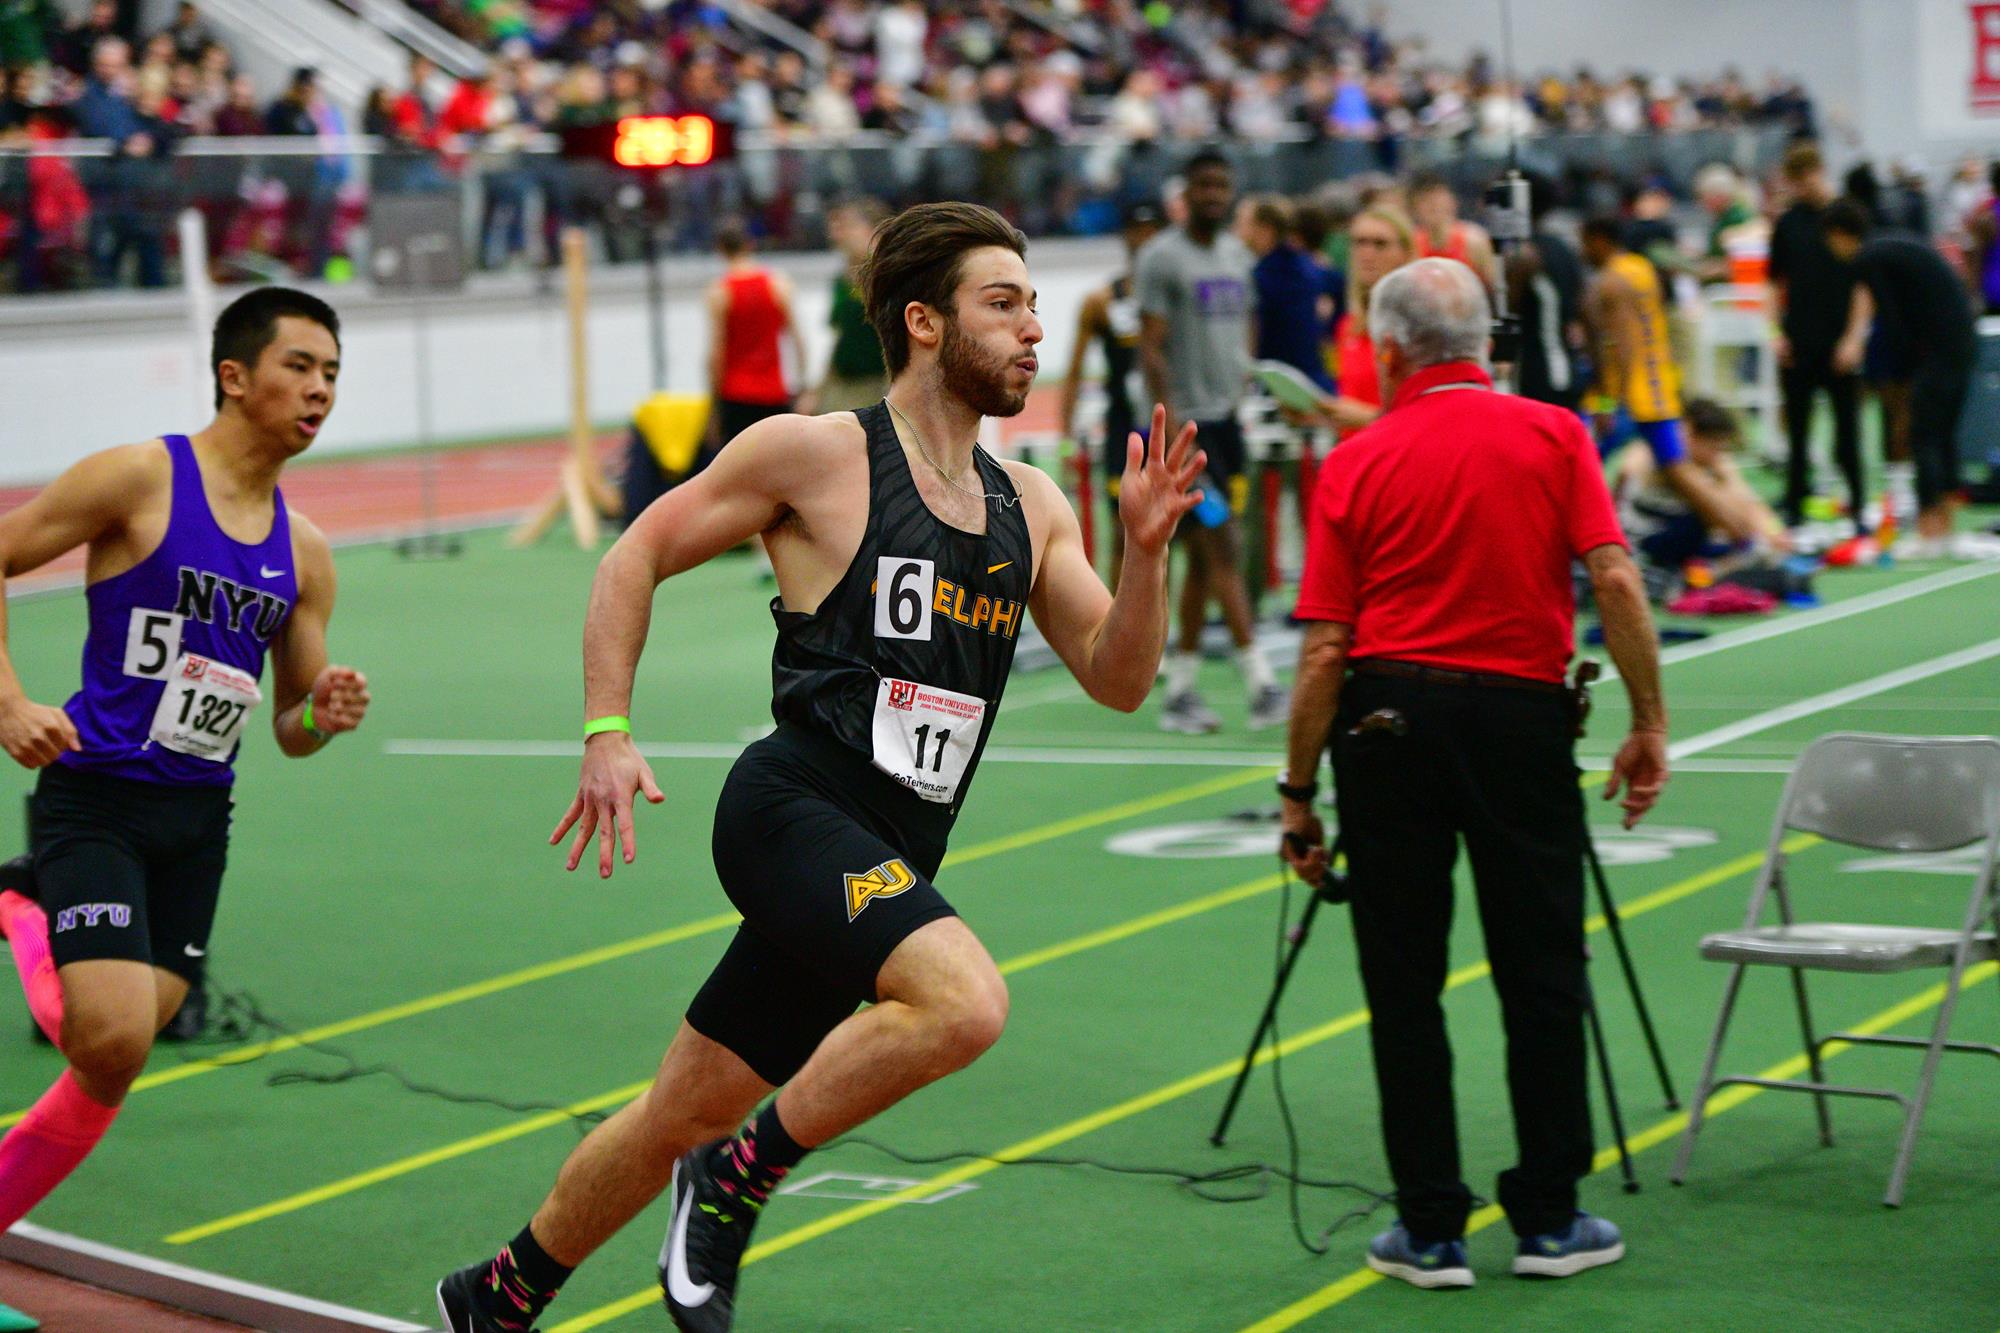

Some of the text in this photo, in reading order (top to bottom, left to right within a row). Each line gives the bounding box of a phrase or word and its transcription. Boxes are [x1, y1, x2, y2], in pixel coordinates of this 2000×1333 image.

[173, 565, 288, 642] NYU
[871, 575, 1022, 640] ELPHI
[889, 562, 922, 635] 6
[137, 616, 171, 674] 5
[178, 689, 246, 738] 1327
[889, 680, 918, 706] BU
[918, 693, 984, 715] BOSTON UNIVERSITY
[914, 723, 951, 772] 11
[892, 773, 948, 793] GoTerriers.com
[843, 859, 916, 923] AU
[56, 903, 131, 933] NYU
